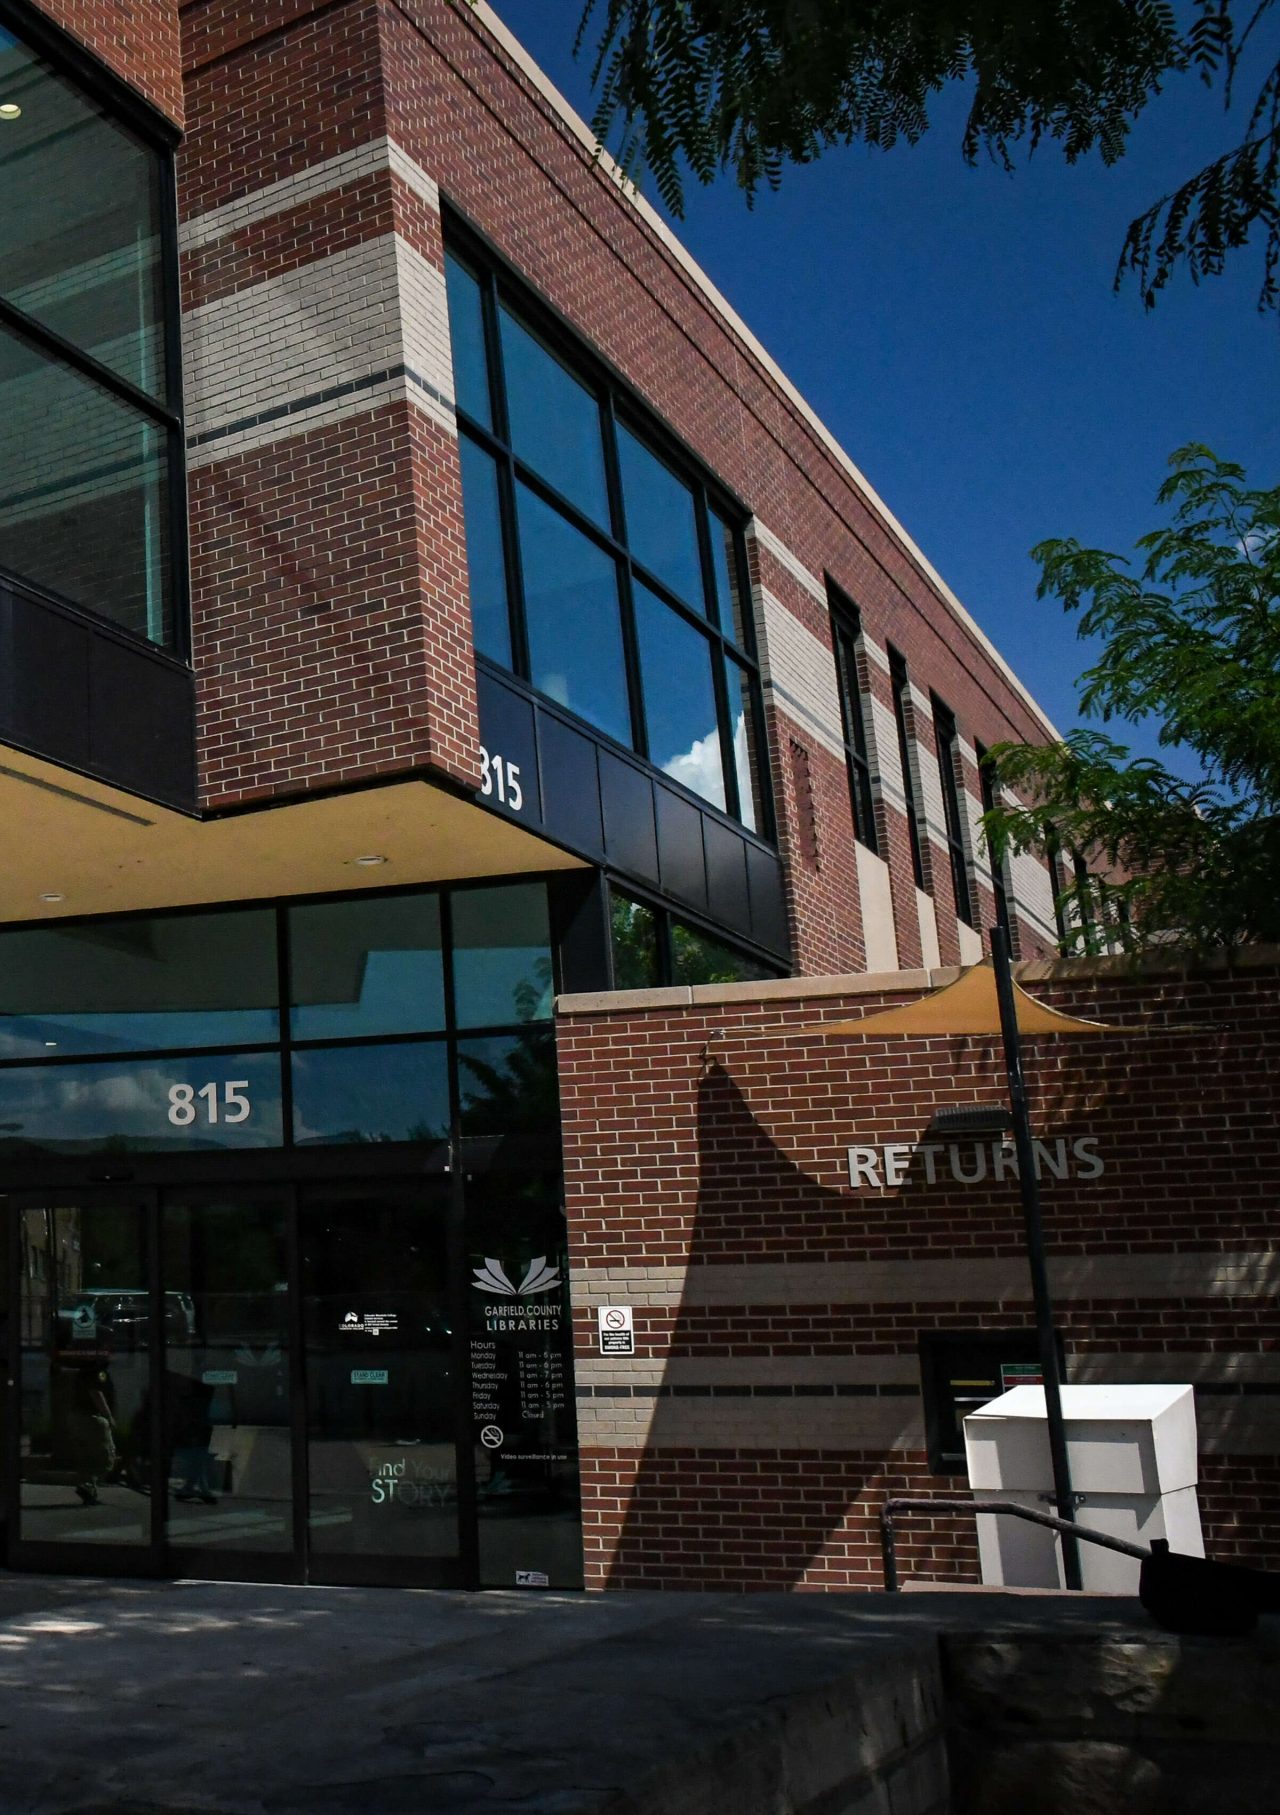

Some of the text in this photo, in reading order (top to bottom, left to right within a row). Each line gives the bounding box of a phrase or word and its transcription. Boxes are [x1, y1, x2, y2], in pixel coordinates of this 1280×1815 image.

[168, 1080, 251, 1126] 815
[848, 1136, 1106, 1188] RETURNS
[484, 1304, 562, 1317] GARFIELD COUNTY
[486, 1319, 559, 1331] LIBRARIES
[470, 1340, 496, 1350] Hours
[470, 1352, 496, 1361] Monday
[471, 1361, 496, 1370] Tuesday
[472, 1371, 508, 1381] Wednesday
[472, 1381, 499, 1391] Thursday
[472, 1391, 491, 1401] Friday
[473, 1401, 500, 1411] Saturday
[474, 1410, 545, 1421] Sunday Closed
[371, 1478, 449, 1507] STORY
